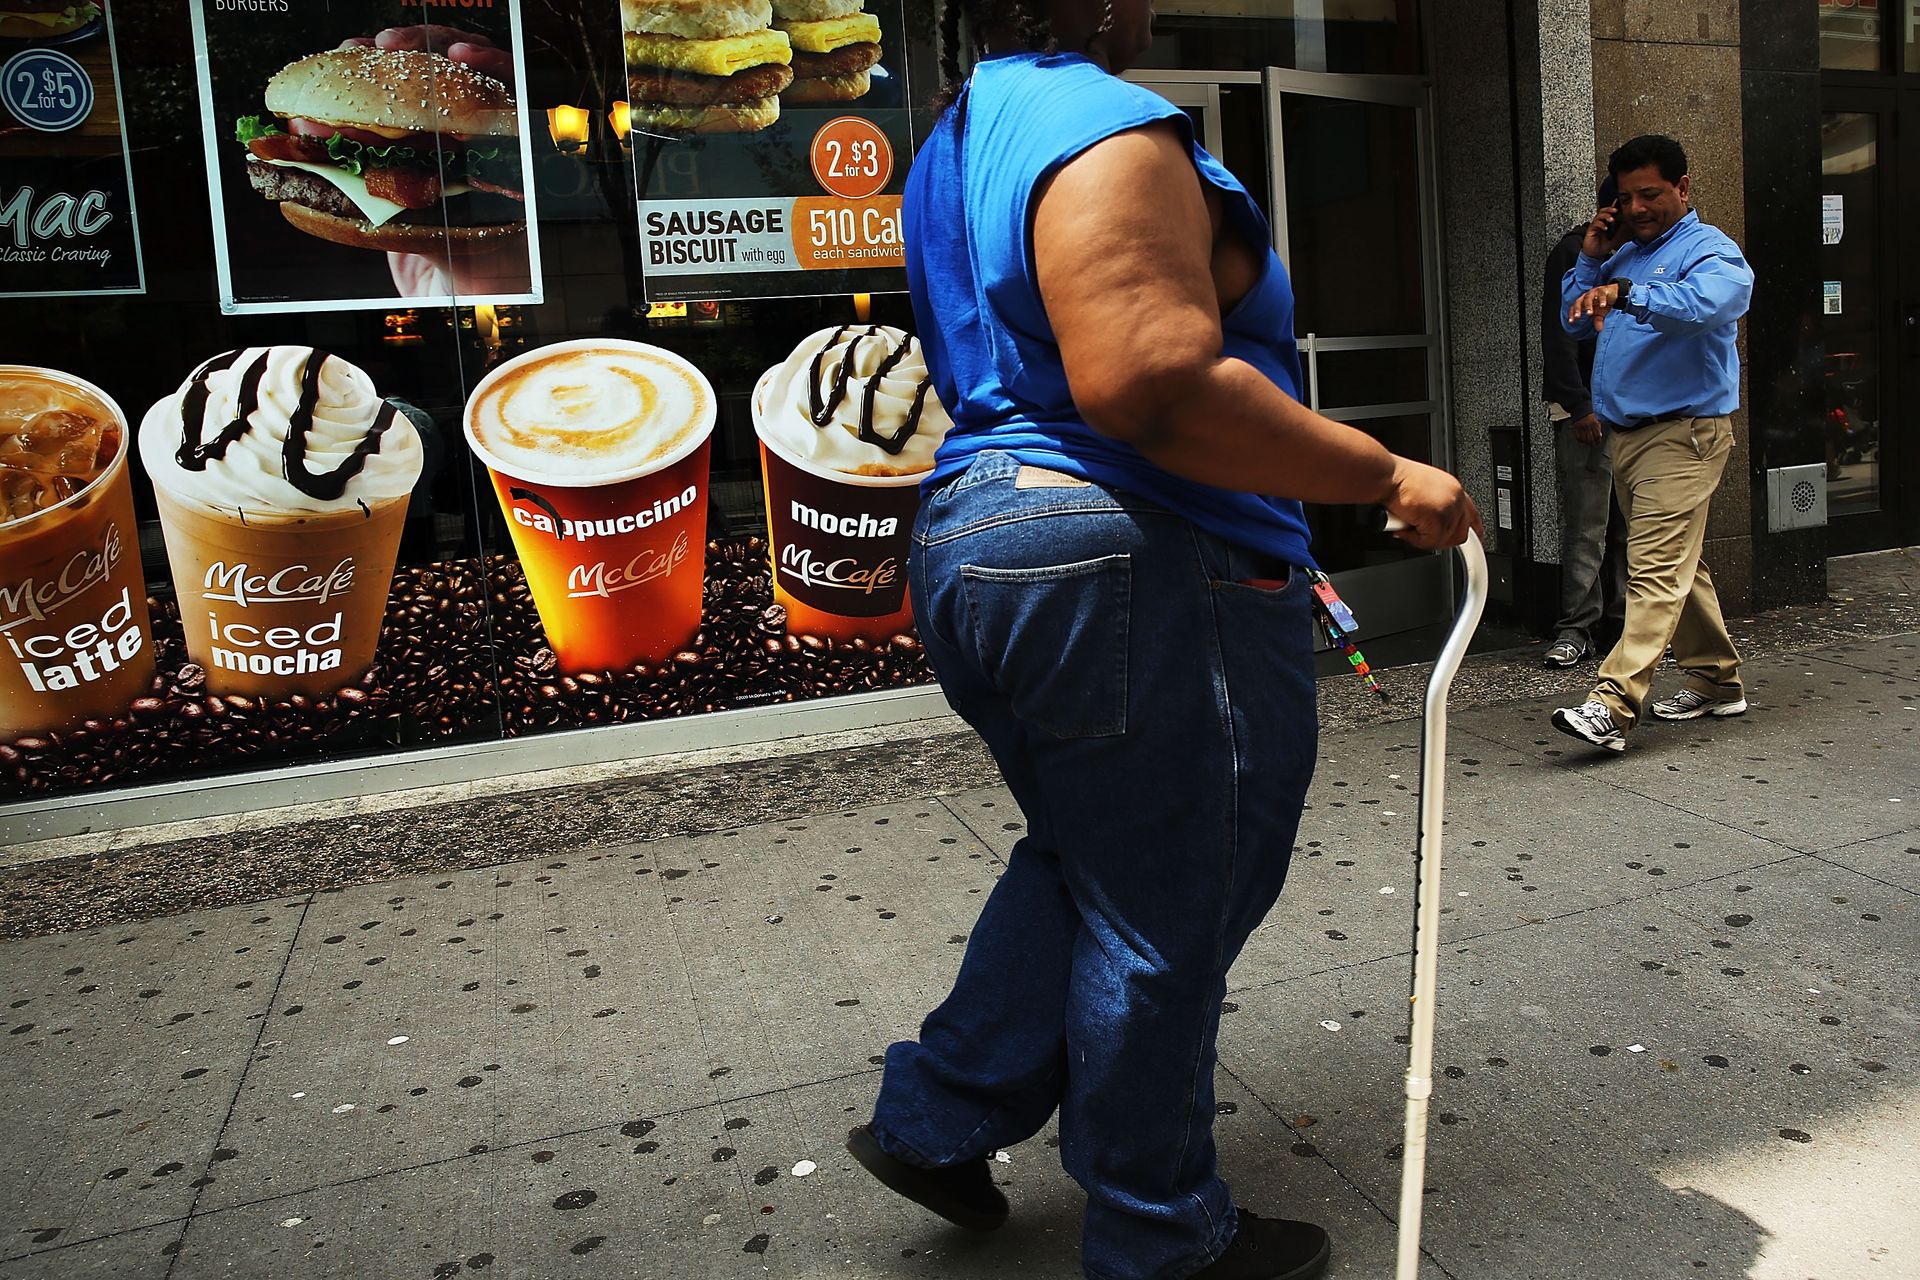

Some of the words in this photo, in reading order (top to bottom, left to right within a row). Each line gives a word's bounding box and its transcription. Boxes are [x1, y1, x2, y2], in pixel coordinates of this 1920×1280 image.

[215, 0, 289, 12] BURGERS
[17, 71, 39, 109] 2
[37, 92, 57, 109] for
[826, 140, 843, 177] 2
[845, 164, 860, 177] for
[0, 186, 113, 249] Mac
[646, 209, 784, 237] SAUSAGE
[809, 208, 857, 247] 510
[862, 208, 905, 245] Cal
[51, 245, 112, 268] Craving
[649, 238, 738, 265] BISCUIT
[741, 248, 764, 262] with
[767, 249, 786, 264] egg
[813, 246, 845, 260] each
[848, 244, 906, 259] sandwich
[512, 485, 697, 542] cappuccino
[791, 500, 898, 538] mocha
[0, 522, 119, 621] McCafé
[204, 557, 356, 608] McCafé
[568, 530, 689, 598] McCafé
[782, 543, 898, 595] McCafé
[3, 586, 132, 659] iced
[208, 611, 343, 649] iced
[20, 625, 143, 692] latte
[211, 646, 342, 676] mocha
